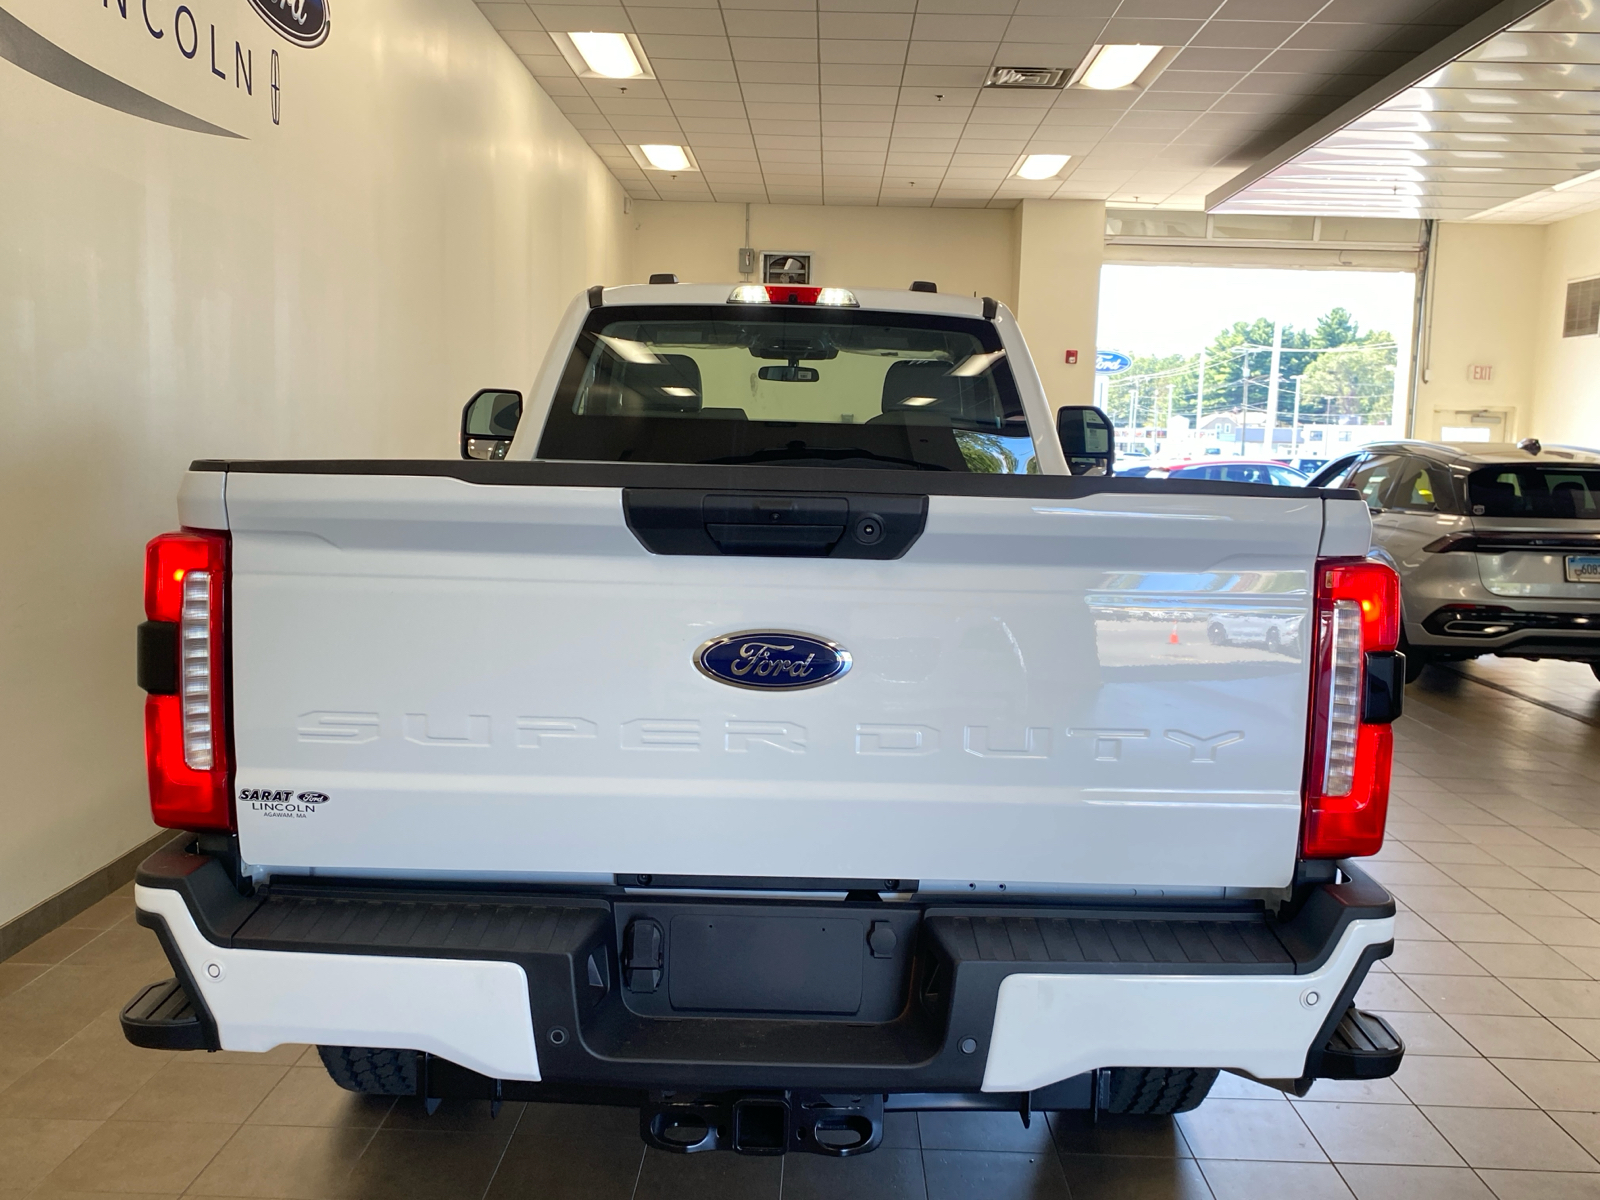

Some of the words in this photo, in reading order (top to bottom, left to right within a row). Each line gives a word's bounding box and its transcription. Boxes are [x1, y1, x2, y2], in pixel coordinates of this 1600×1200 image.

[1473, 365, 1492, 381] EXIT
[731, 642, 816, 678] Ford
[297, 711, 807, 754] SUPER
[855, 723, 1246, 764] DUTY
[239, 788, 294, 803] SARAT
[301, 792, 325, 803] Ford
[252, 802, 316, 813] LINCOLN
